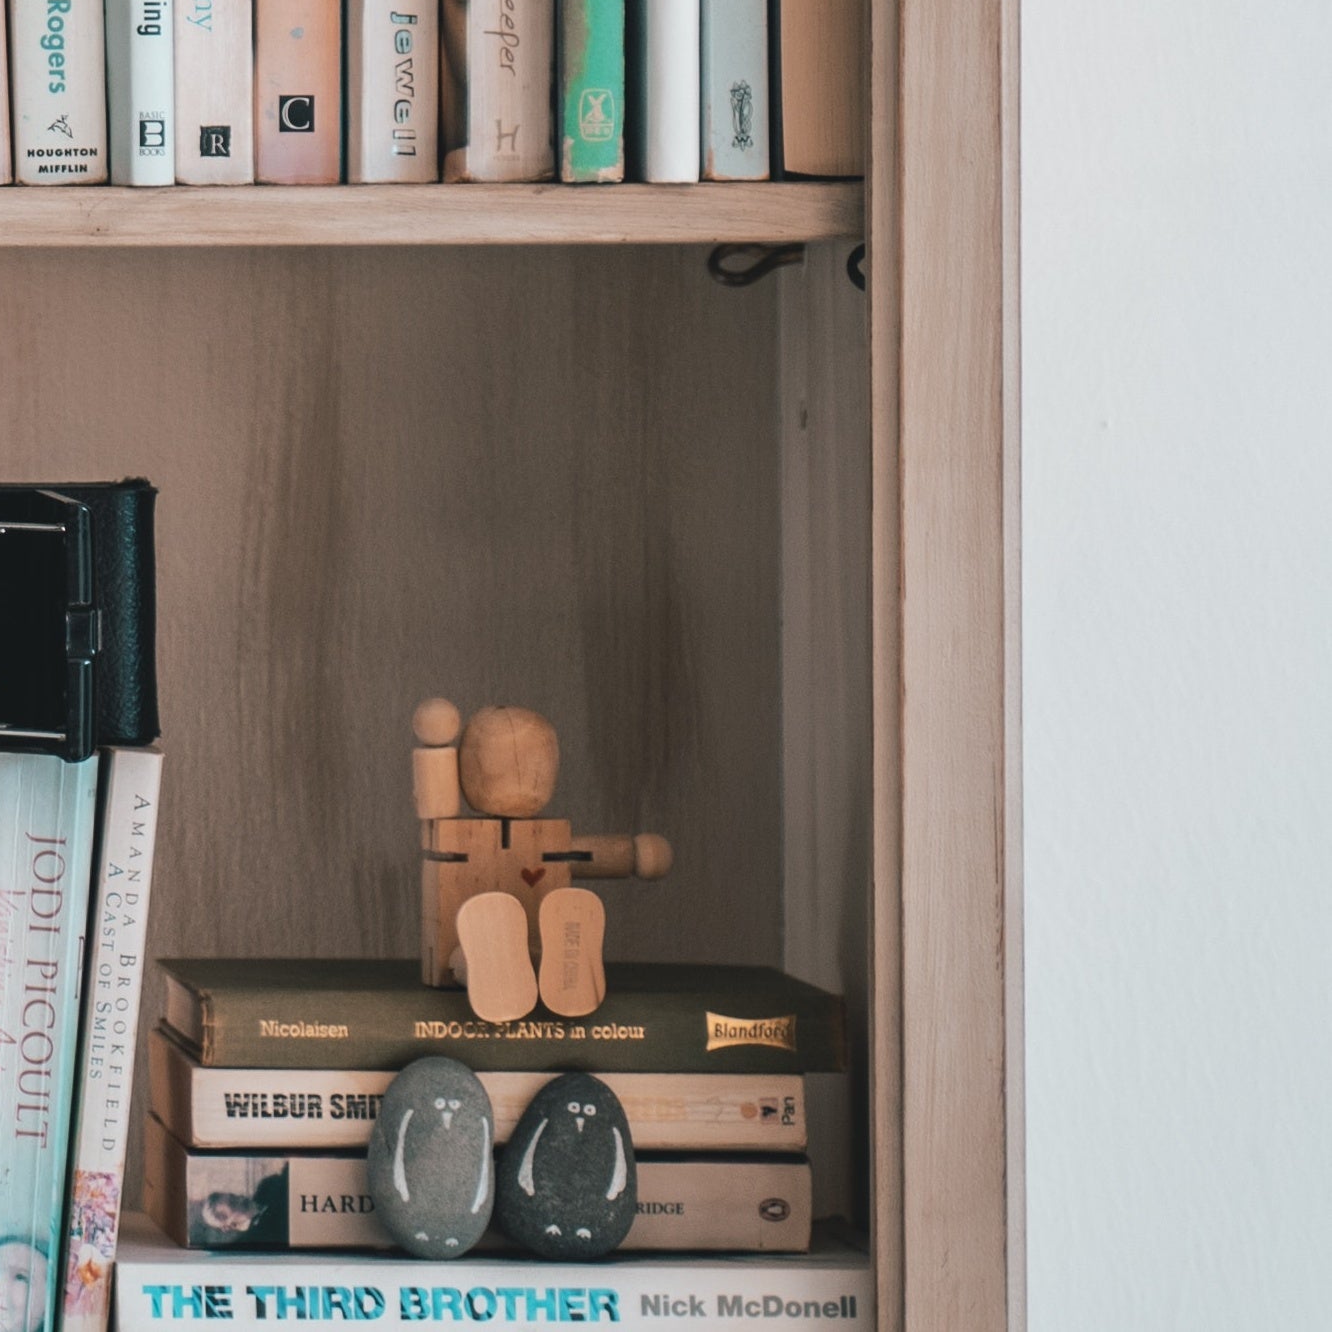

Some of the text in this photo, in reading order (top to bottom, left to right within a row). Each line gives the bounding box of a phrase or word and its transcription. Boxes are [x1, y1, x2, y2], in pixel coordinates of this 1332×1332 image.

[28, 148, 99, 158] HOUGHTON
[39, 165, 88, 173] MIFFLIN
[259, 1020, 349, 1038] Nicolaisen
[224, 1093, 324, 1119] WILBUR
[142, 1284, 620, 1322] THE THIRD BROTHER
[640, 1291, 857, 1318] Nick McDonell
